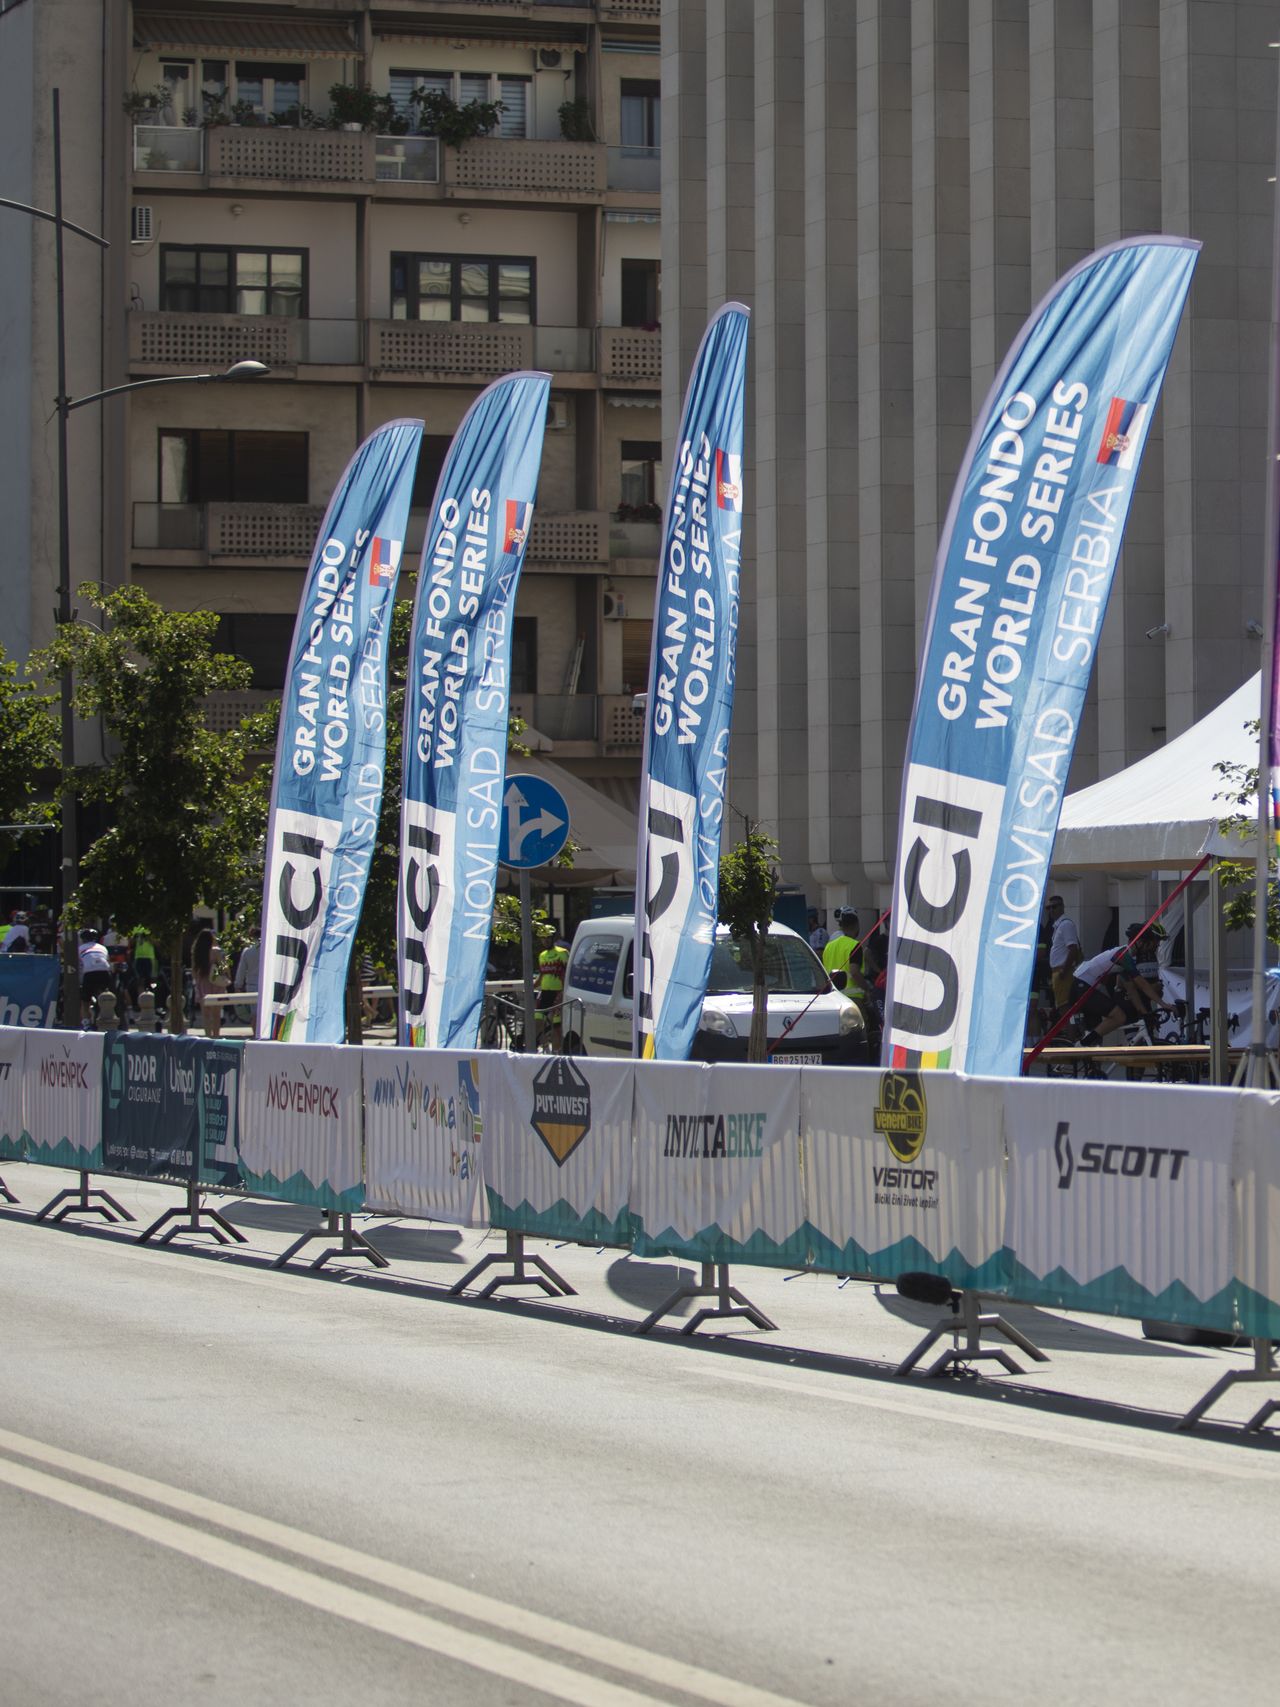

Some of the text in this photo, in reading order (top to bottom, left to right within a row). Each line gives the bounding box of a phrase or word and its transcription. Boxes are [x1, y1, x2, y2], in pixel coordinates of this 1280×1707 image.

[292, 537, 347, 777] GRAN FONDO
[417, 496, 461, 764] GRAN FONDO
[434, 486, 492, 770] WORLD SERIES
[653, 439, 692, 737] GRAN FONO
[676, 430, 716, 745] WORLD SERIES
[936, 389, 1037, 722] GRAN FONDO
[974, 378, 1090, 731] WORLD SERIES
[319, 654, 351, 782] WORLD
[329, 600, 390, 940] NOVI SAD SERBIA
[462, 570, 516, 941] NOVI SAD SERBIA
[994, 484, 1123, 951] NOVI SAD SERBIA
[272, 830, 325, 1007] UCI
[404, 824, 442, 1016] UCI
[890, 794, 984, 1038] UCI
[265, 1071, 340, 1120] MÖVENPICK
[535, 1093, 589, 1117] PUT-INVEST
[872, 1166, 937, 1191] VISITOR
[1077, 1140, 1190, 1181] SCOTT
